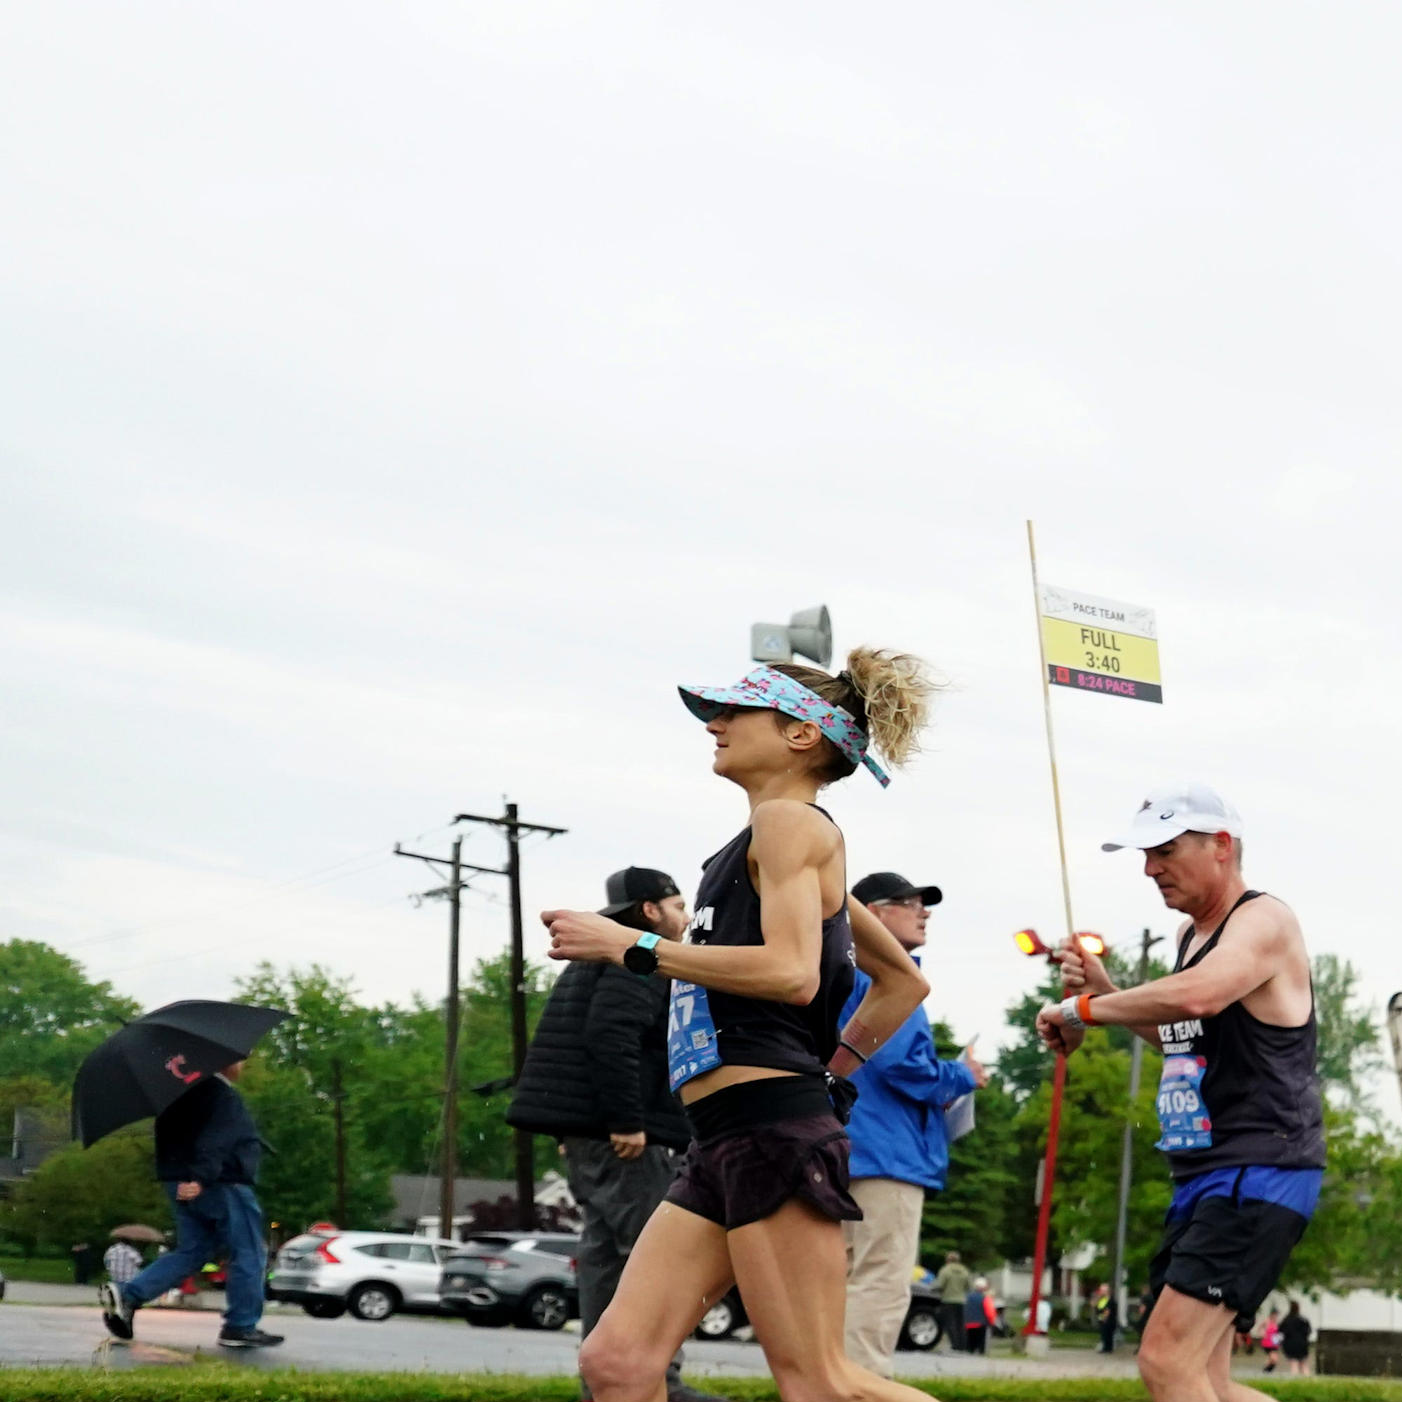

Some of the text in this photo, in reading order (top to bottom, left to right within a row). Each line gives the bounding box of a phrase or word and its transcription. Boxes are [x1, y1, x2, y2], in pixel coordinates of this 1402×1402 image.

[1072, 602, 1125, 622] PACE TEAM
[1080, 627, 1122, 652] FULL
[1085, 651, 1121, 673] 3:40
[1077, 673, 1137, 696] 8:24 PACE
